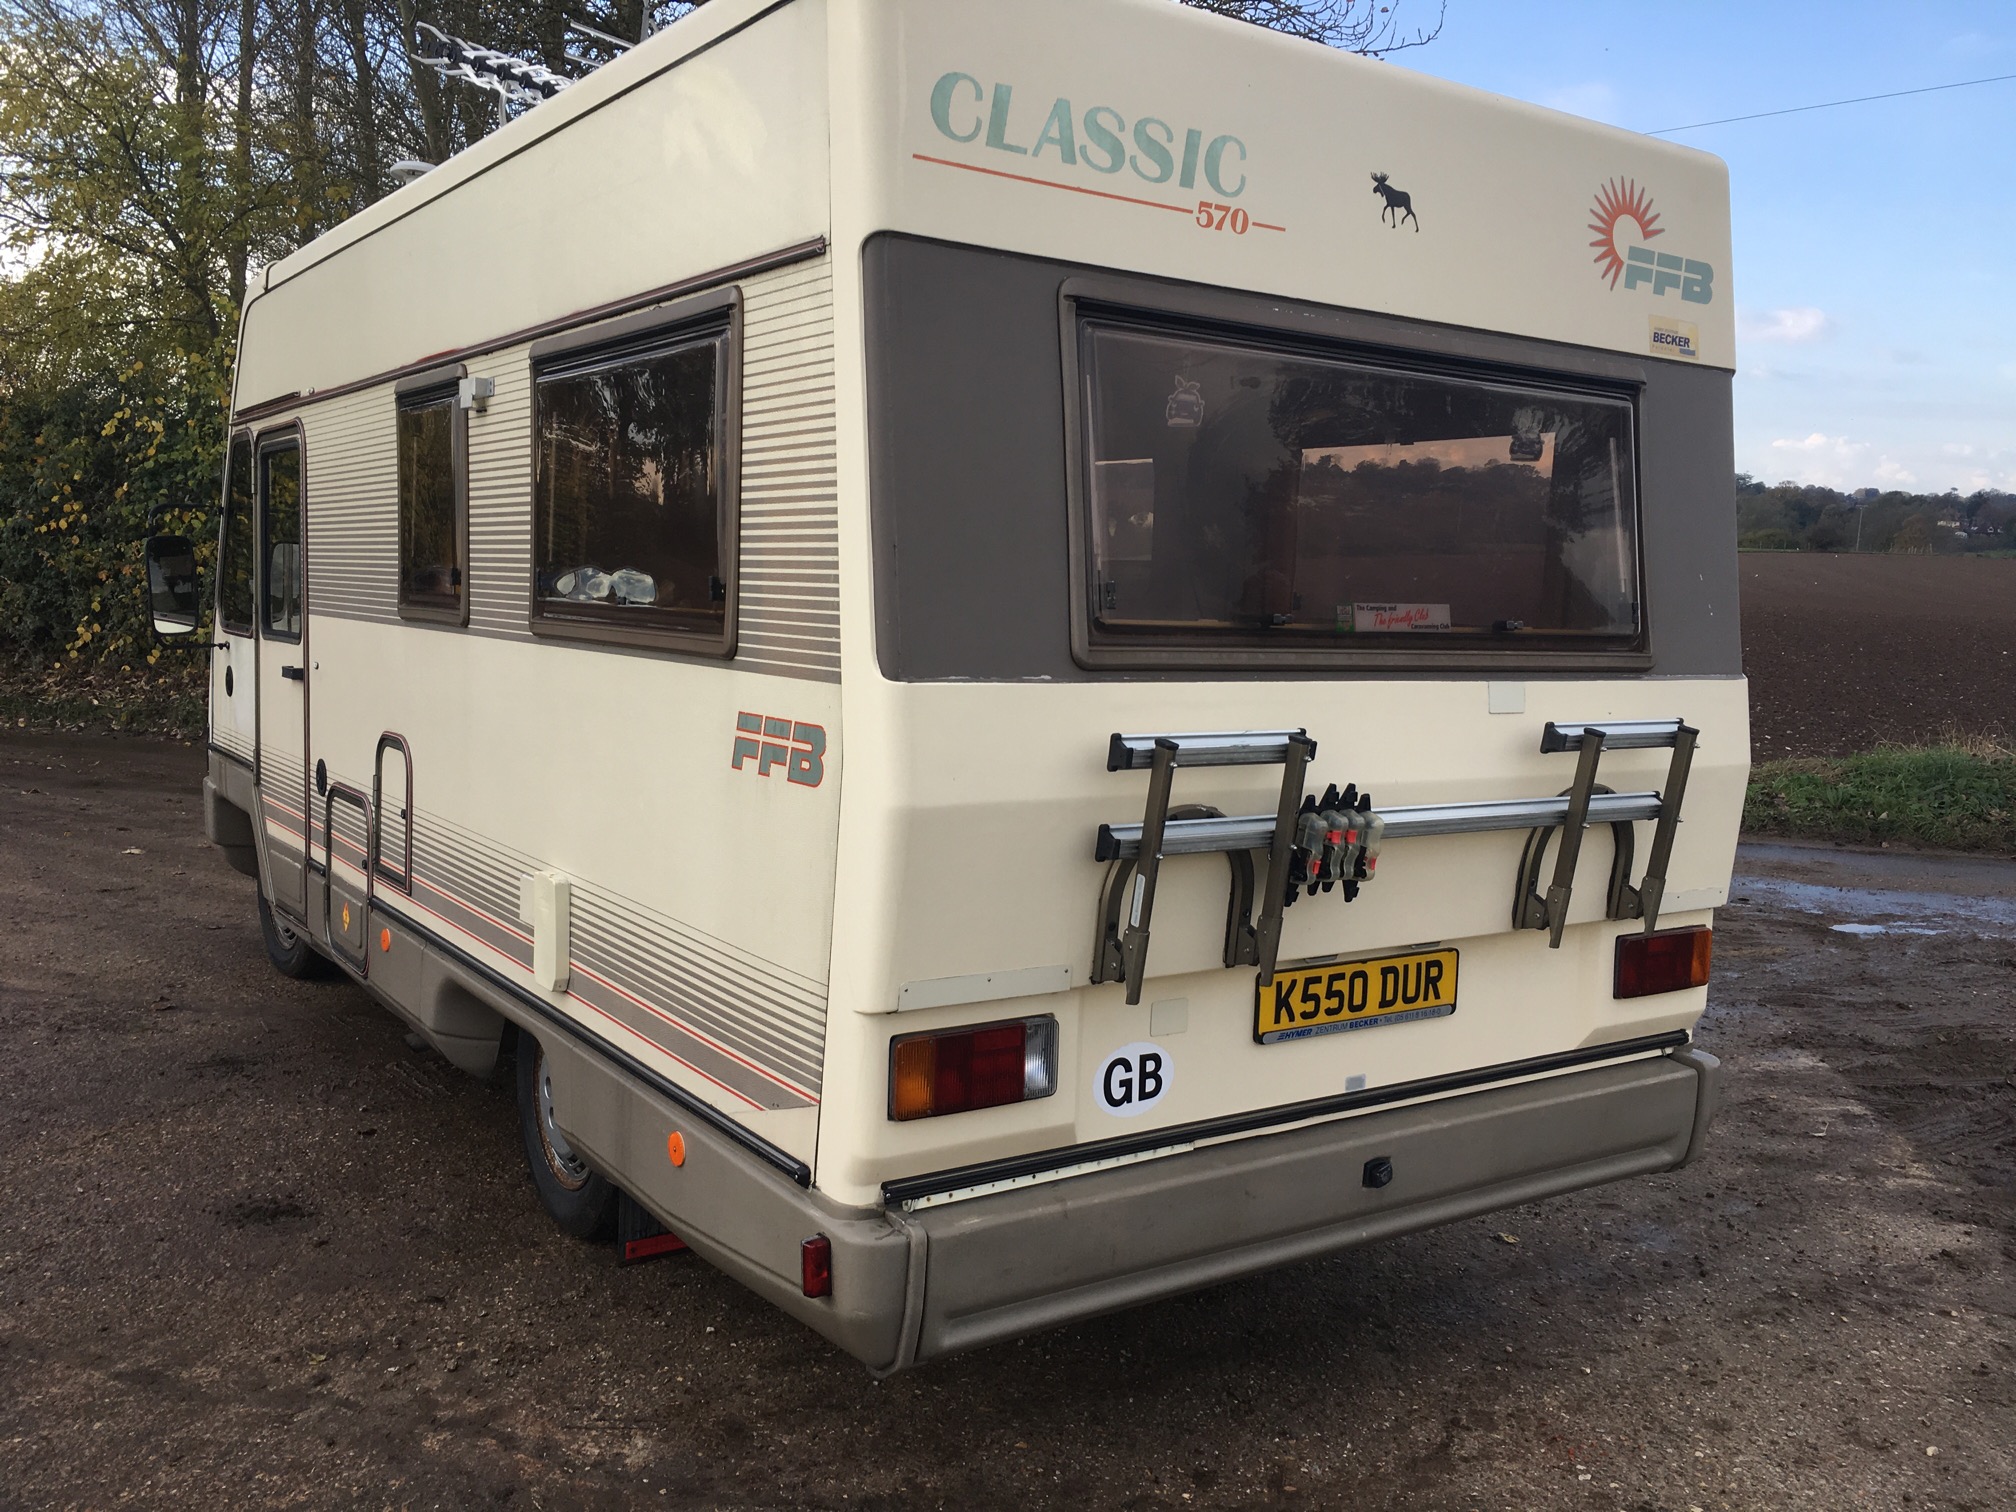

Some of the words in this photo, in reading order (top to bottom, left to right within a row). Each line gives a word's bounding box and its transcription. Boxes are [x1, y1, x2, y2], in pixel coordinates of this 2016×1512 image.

[930, 71, 1247, 198] CLASSIC
[1195, 200, 1249, 235] 570
[1653, 331, 1690, 348] BECKER
[1366, 604, 1387, 613] Camping
[1373, 612, 1386, 628] The
[1414, 608, 1429, 622] Club
[1273, 970, 1369, 1025] K550
[1378, 959, 1443, 1009] DUR
[1284, 1028, 1313, 1040] HYMER
[1315, 1022, 1349, 1035] ZENTRUM
[1349, 1018, 1379, 1029] BECKER
[1103, 1052, 1163, 1108] GB
